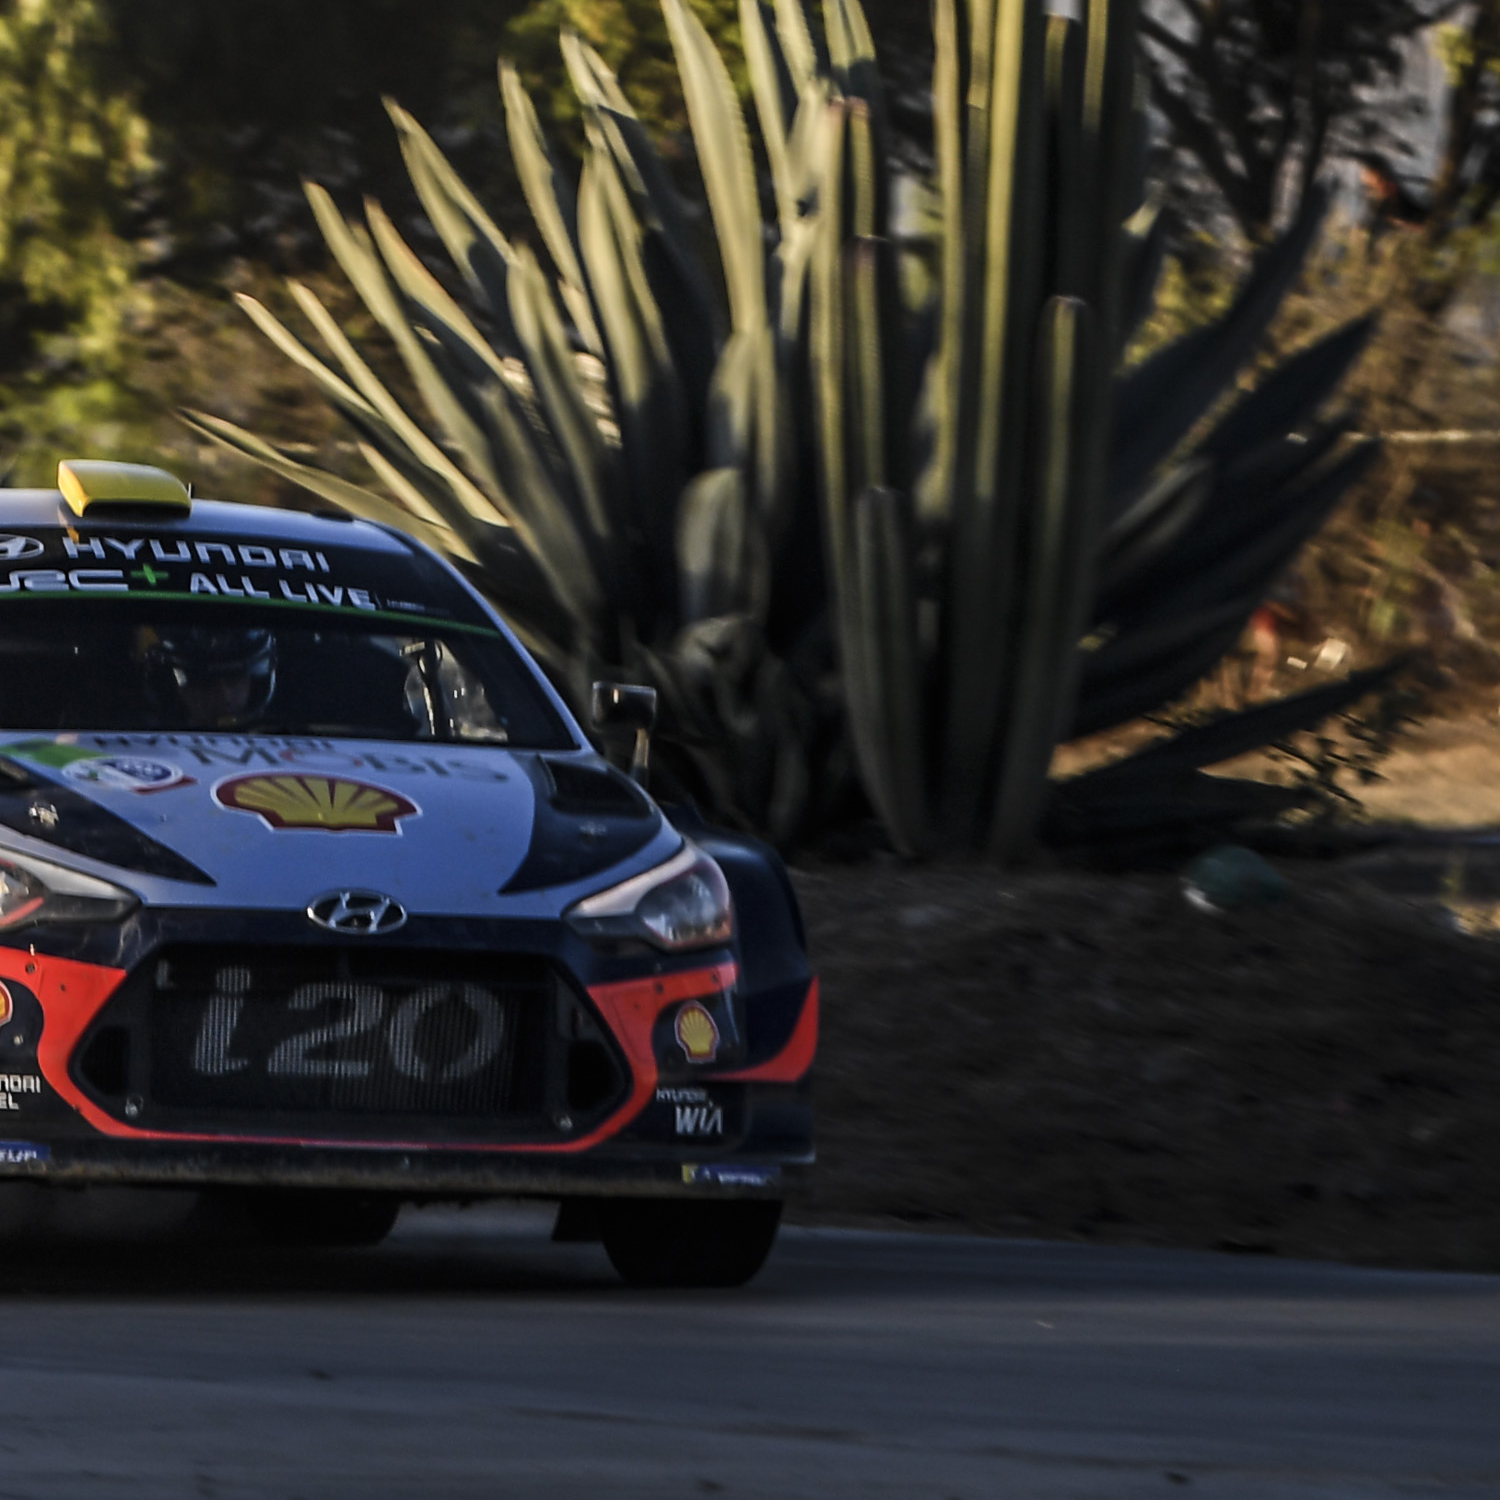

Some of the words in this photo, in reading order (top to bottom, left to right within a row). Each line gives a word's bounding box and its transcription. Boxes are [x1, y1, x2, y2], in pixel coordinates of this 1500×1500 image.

[62, 536, 330, 573] HYUNDAI
[190, 572, 270, 599] ALL
[279, 579, 376, 611] LIVE
[194, 967, 503, 1082] i20
[675, 1100, 722, 1134] WIA
